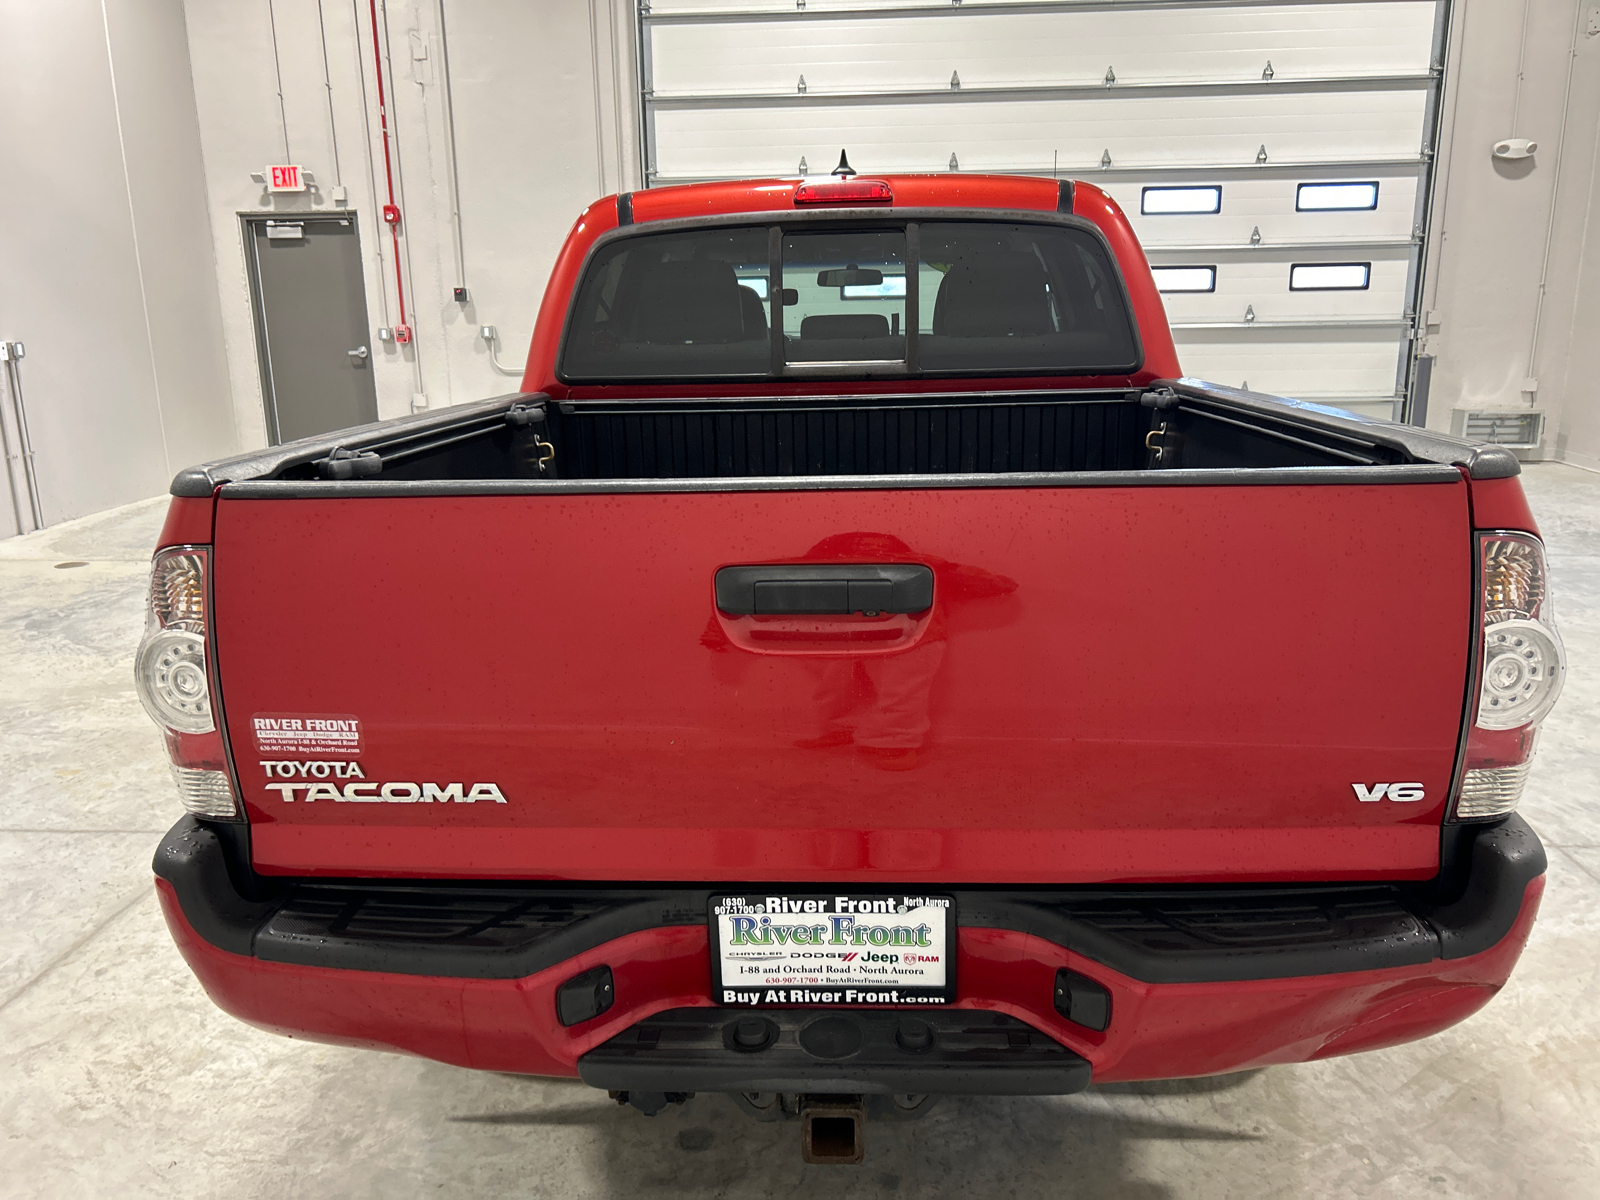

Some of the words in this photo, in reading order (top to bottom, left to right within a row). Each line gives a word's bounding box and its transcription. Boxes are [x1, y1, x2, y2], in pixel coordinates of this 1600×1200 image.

[272, 166, 297, 188] EXIT
[254, 718, 303, 730] RIVER
[306, 719, 359, 731] FRONT
[299, 746, 360, 754] BuyAtRiverFront.com
[259, 761, 365, 778] TOYOTA
[264, 782, 508, 803] TACOMA
[1351, 782, 1425, 802] V6
[722, 897, 746, 907] (630)
[765, 896, 827, 913] River
[835, 896, 896, 913] Front
[903, 896, 923, 907] North
[925, 897, 950, 908] Aurora
[714, 905, 755, 915] 907-1700
[728, 915, 828, 946] River
[827, 914, 932, 947] Front
[860, 951, 899, 965] Jeep
[917, 955, 940, 963] RAM
[739, 965, 761, 974] I-88
[762, 965, 780, 974] and
[783, 965, 823, 974] Orchard
[826, 965, 851, 974] Road
[859, 965, 888, 975] North
[890, 966, 924, 975] Aurora
[765, 976, 819, 984] 630-907-1700
[825, 977, 899, 985] BuyAtRiverFront.com
[723, 990, 760, 1006] Buy
[765, 990, 787, 1003] At
[790, 990, 842, 1003] River
[845, 990, 946, 1004] Front.com
